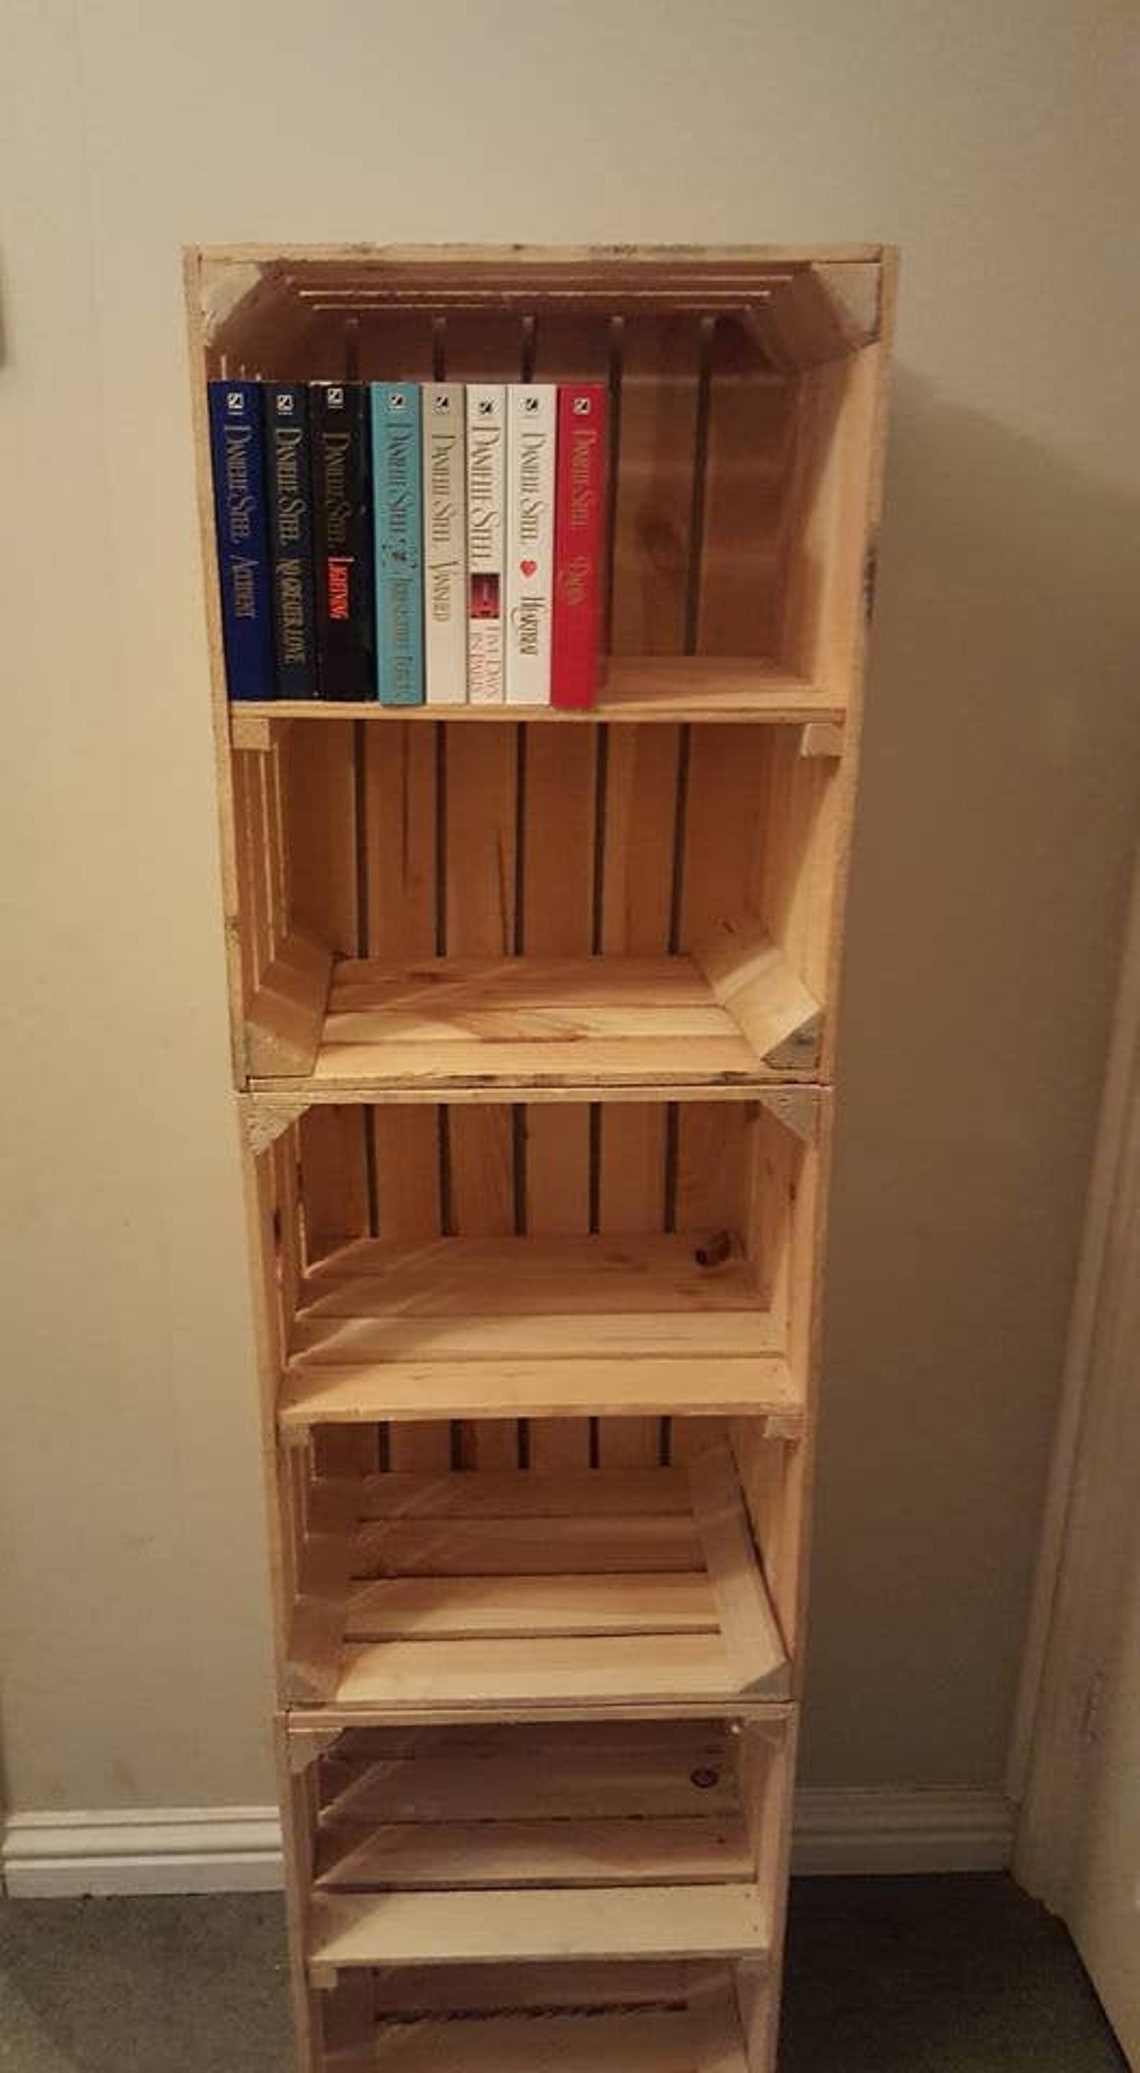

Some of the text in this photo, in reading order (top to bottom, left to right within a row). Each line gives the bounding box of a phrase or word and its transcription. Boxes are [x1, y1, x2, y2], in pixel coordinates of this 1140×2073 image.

[223, 424, 251, 493] DANIELLE
[275, 427, 302, 496] DANIELLE
[431, 434, 456, 545] DANIELLE STEEL
[519, 432, 546, 545] DANIELLE STEEL
[229, 488, 256, 545] STEEL
[279, 493, 307, 547] STEEL
[470, 425, 502, 567] DANIELLE STEEL
